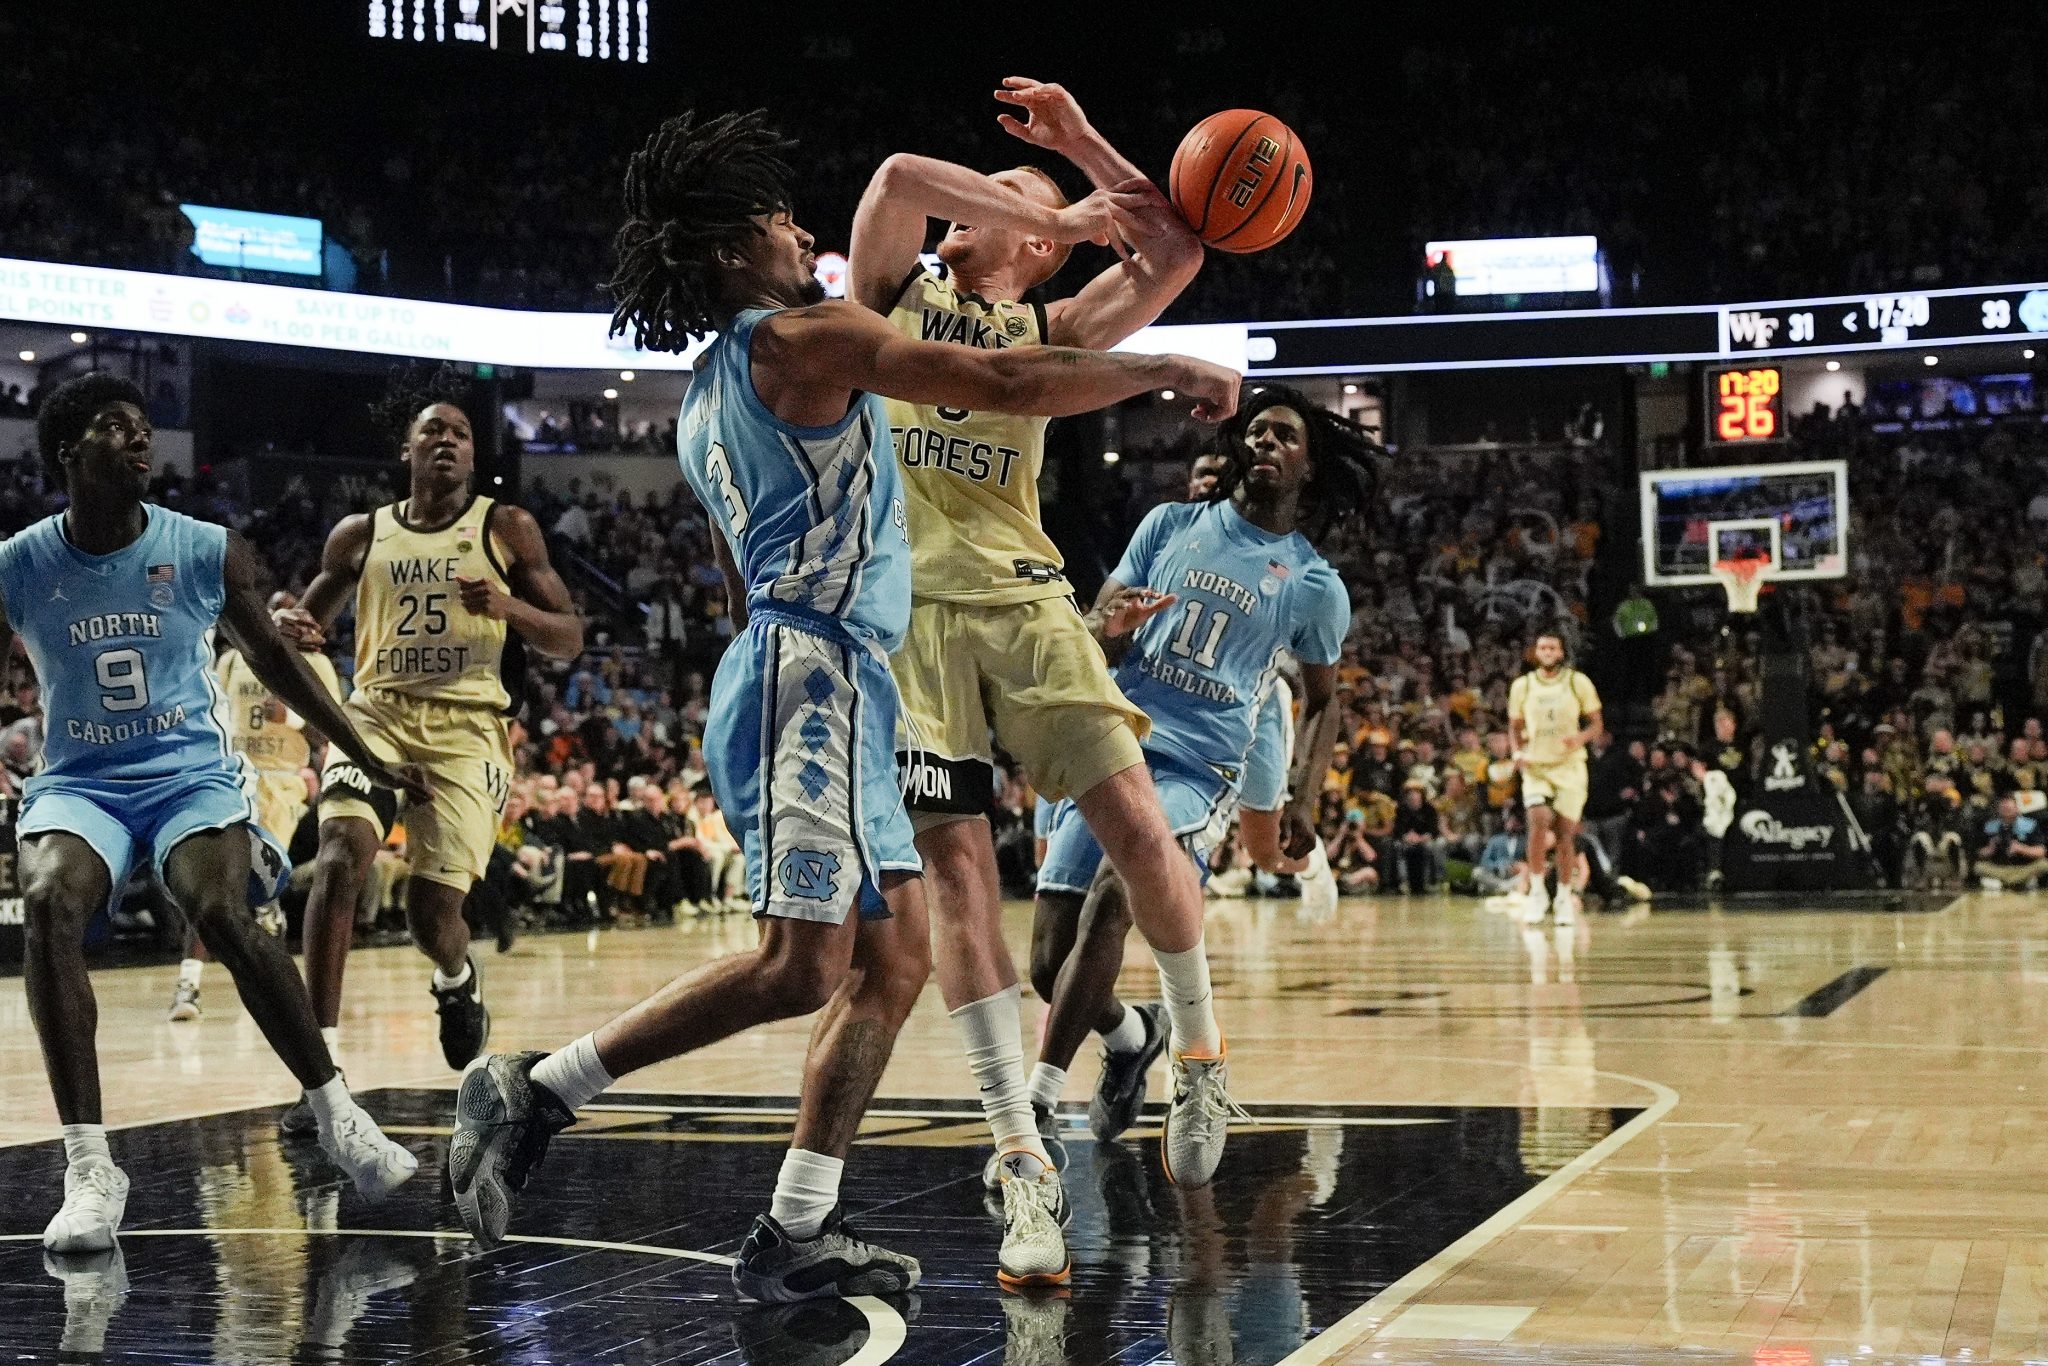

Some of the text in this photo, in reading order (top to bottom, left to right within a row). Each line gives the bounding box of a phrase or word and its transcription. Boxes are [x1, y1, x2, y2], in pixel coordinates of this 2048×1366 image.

[1227, 135, 1280, 209] ELITE
[27, 297, 114, 321] POINTS
[1718, 396, 1776, 440] 26
[705, 441, 750, 539] 3
[390, 557, 459, 585] WAKE
[1182, 568, 1257, 616] NORTH
[68, 612, 161, 647] NORTH
[396, 593, 447, 636] 25
[1170, 599, 1230, 669] 11
[95, 647, 149, 712] 9
[376, 646, 467, 674] FOREST
[1137, 656, 1237, 704] CAROLINA
[67, 703, 187, 745] CAROLINA
